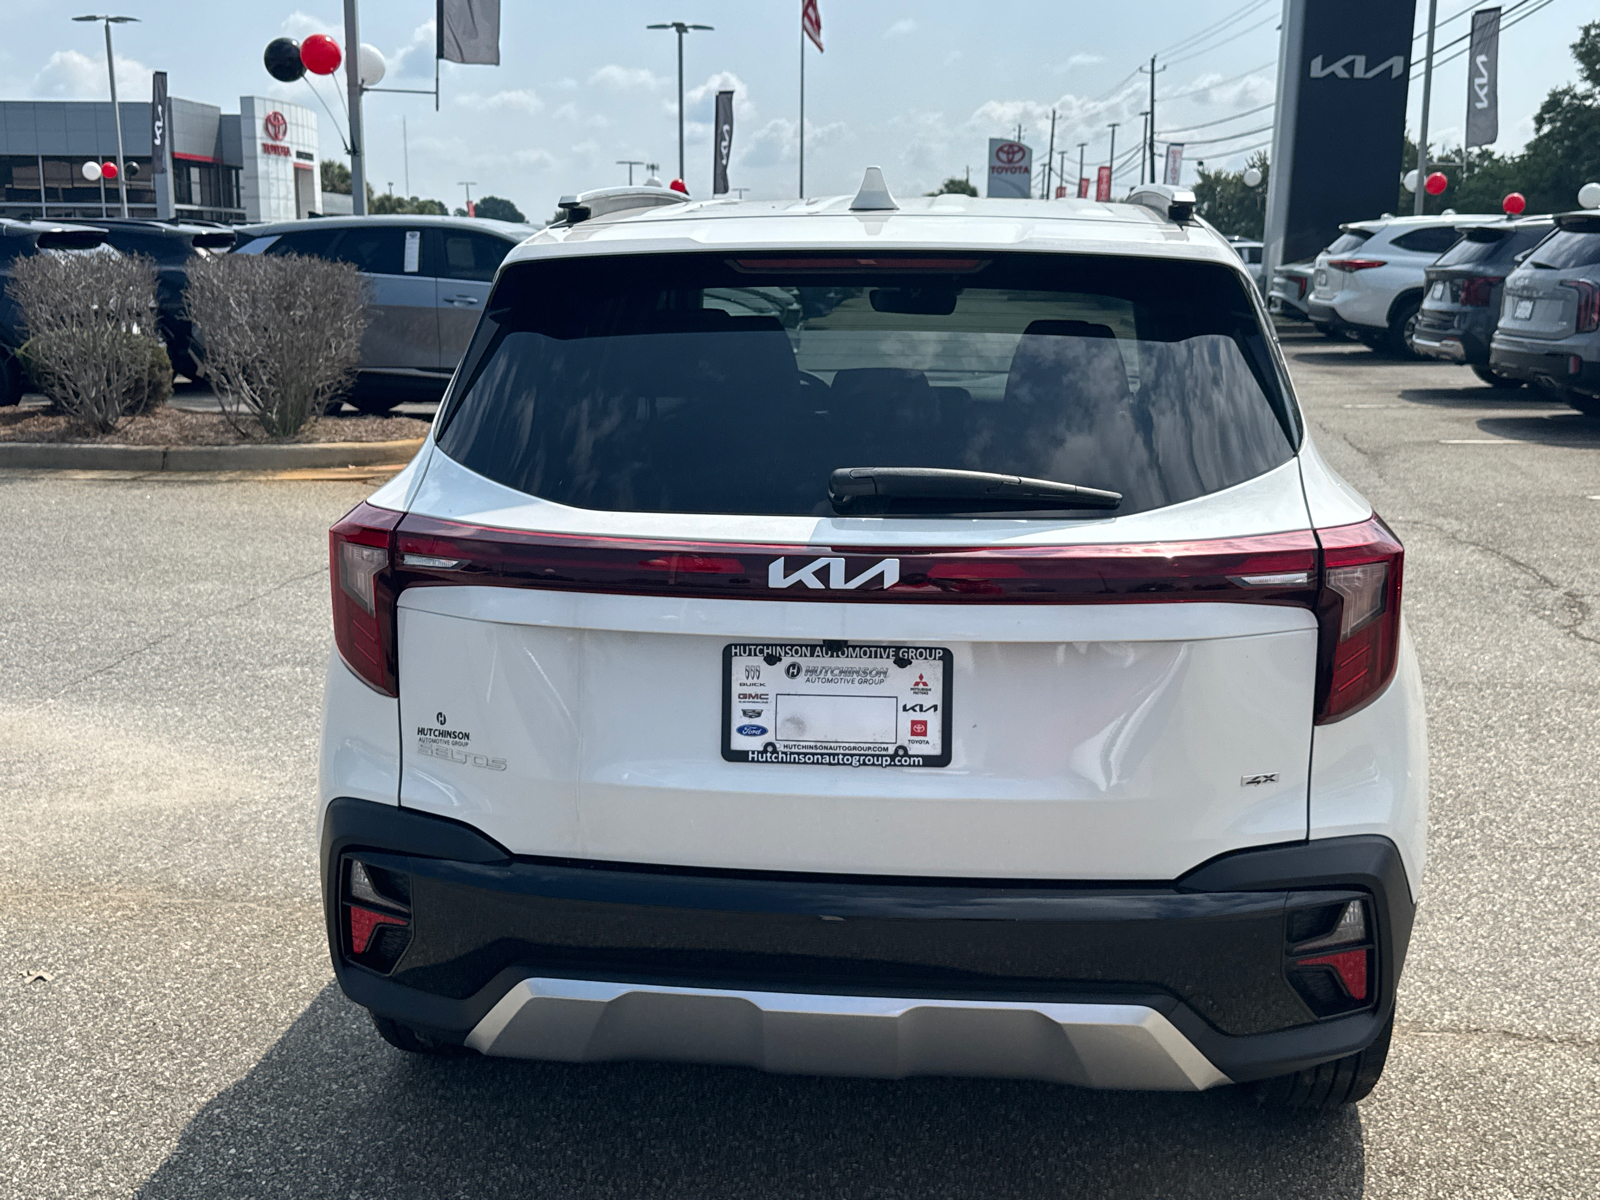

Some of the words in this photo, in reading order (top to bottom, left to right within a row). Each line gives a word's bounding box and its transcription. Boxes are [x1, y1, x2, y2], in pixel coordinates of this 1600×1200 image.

[1310, 54, 1404, 79] KIA
[991, 165, 1030, 174] TOYOTA
[768, 556, 900, 590] KIA
[732, 645, 810, 657] HUTCHINSON
[899, 648, 943, 660] GROUP
[804, 666, 888, 678] HUTCHINSON
[902, 703, 938, 713] KIA
[417, 727, 470, 740] HUTCHINSON
[742, 726, 762, 735] Ford
[418, 737, 450, 745] AUTOMOTIVE
[783, 744, 889, 752] HUTCHINSONAUTOGROUP.COM
[417, 743, 507, 771] SELTOS
[748, 750, 923, 767] Hutchinsonautogroup.com
